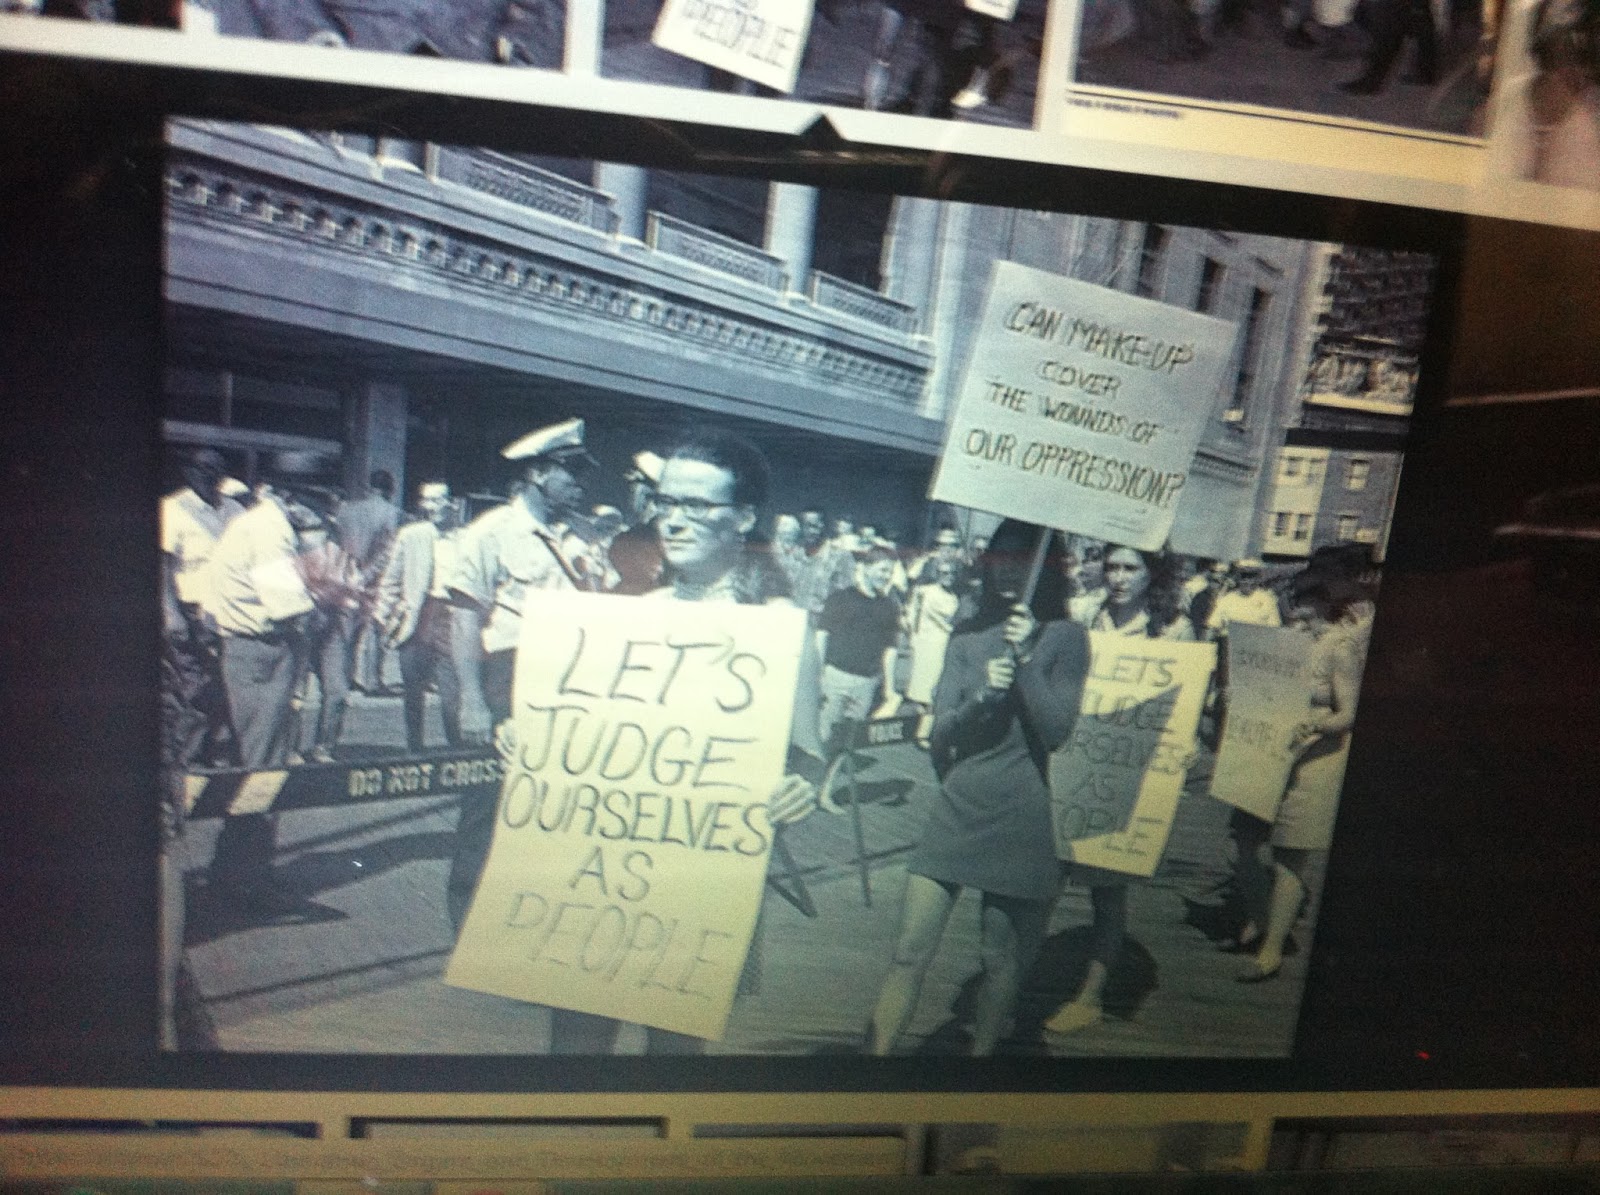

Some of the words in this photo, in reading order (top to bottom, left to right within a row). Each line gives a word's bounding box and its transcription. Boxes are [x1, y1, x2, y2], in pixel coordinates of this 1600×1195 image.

[1003, 301, 1063, 341] CAN
[1066, 316, 1194, 373] MAKE-UP
[984, 378, 1032, 413] THE
[1126, 419, 1165, 446] OF
[1037, 360, 1121, 399] COVER
[965, 428, 1018, 467] OUR
[1021, 441, 1187, 509] OPPRESSION?
[556, 626, 768, 713] LET'S
[349, 768, 383, 797] DO
[386, 763, 434, 794] NOT
[520, 702, 763, 793] JUDGE
[503, 773, 773, 857] OURSELVES
[567, 846, 655, 902] AS
[507, 892, 737, 1001] PEOPLE
